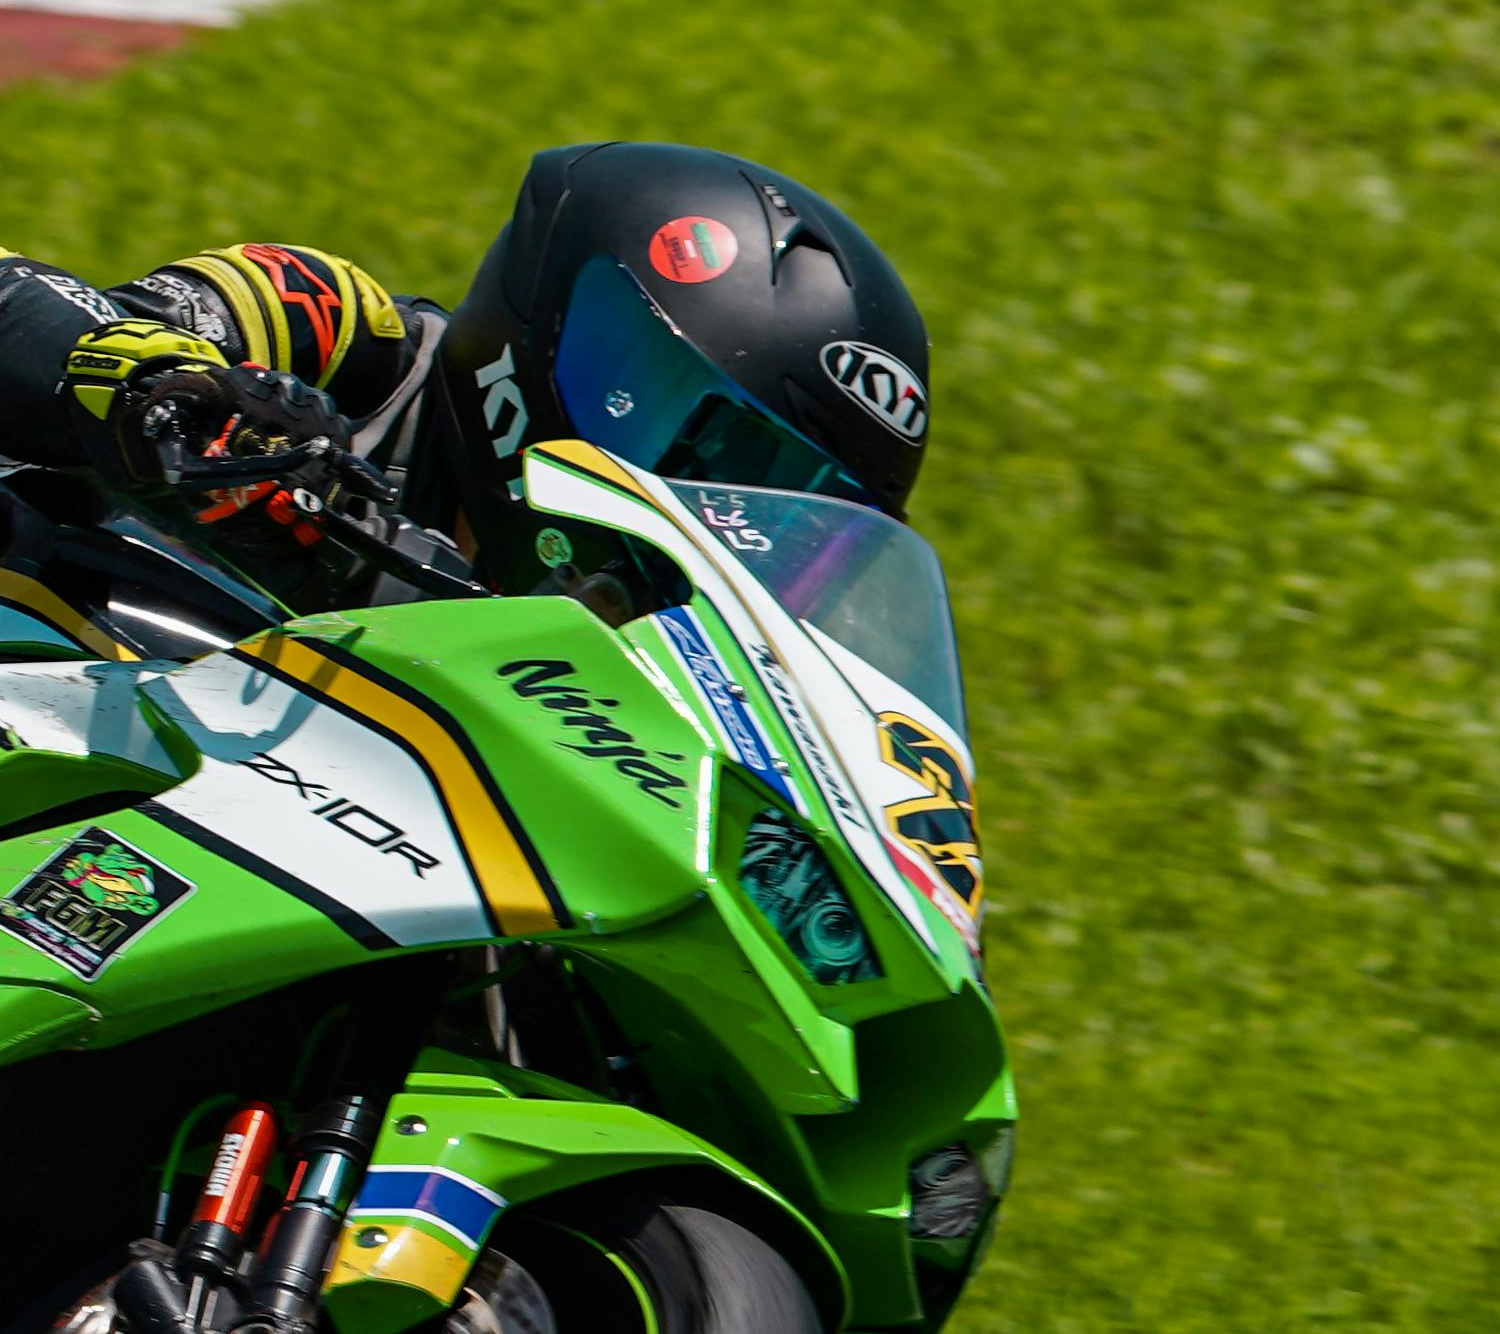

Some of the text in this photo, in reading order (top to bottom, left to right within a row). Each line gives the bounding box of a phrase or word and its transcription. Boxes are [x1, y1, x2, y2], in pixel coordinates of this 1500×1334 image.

[824, 344, 927, 439] KYT
[497, 659, 688, 809] Ninja
[236, 751, 443, 880] ZX-10R
[22, 879, 129, 952] FGM
